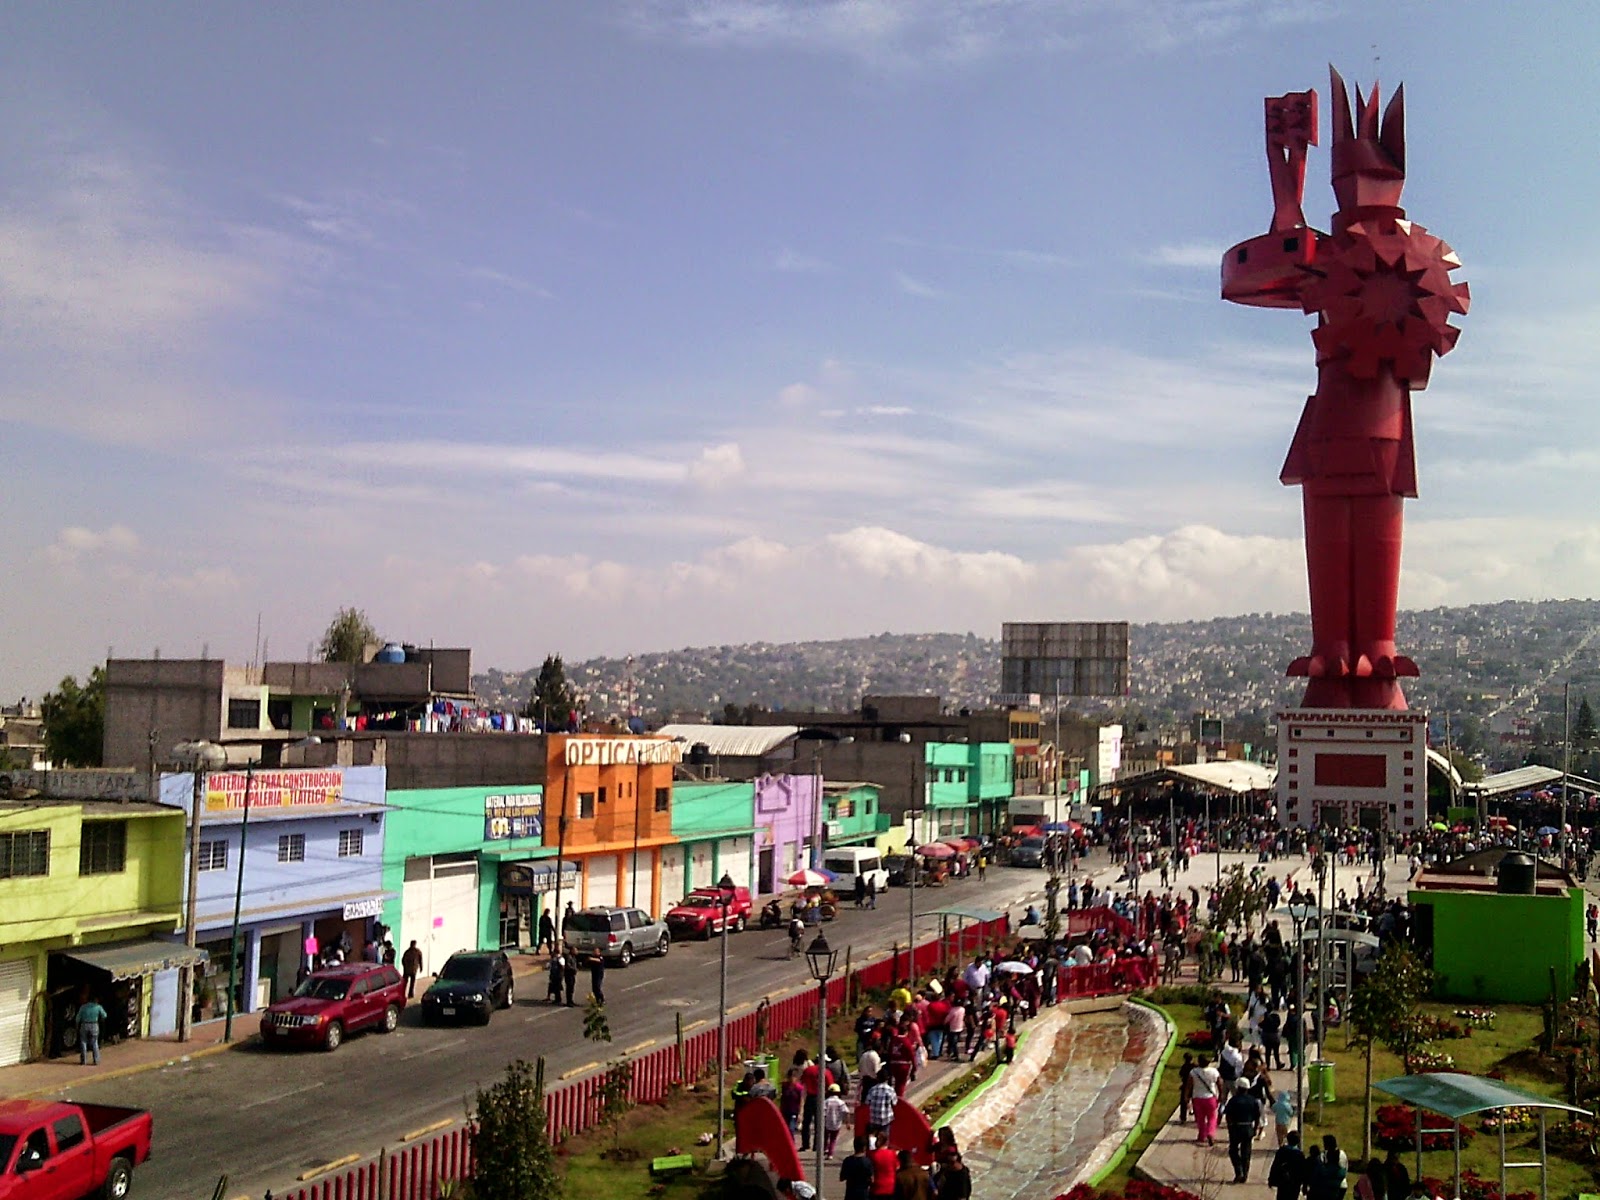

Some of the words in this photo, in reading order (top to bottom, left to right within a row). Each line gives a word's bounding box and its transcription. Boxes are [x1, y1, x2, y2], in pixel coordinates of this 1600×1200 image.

[568, 741, 638, 764] OPTICA
[208, 774, 259, 791] MATERIAES
[260, 774, 282, 790] PARA
[283, 772, 342, 789] CONSTRUCCION
[225, 792, 232, 808] Y
